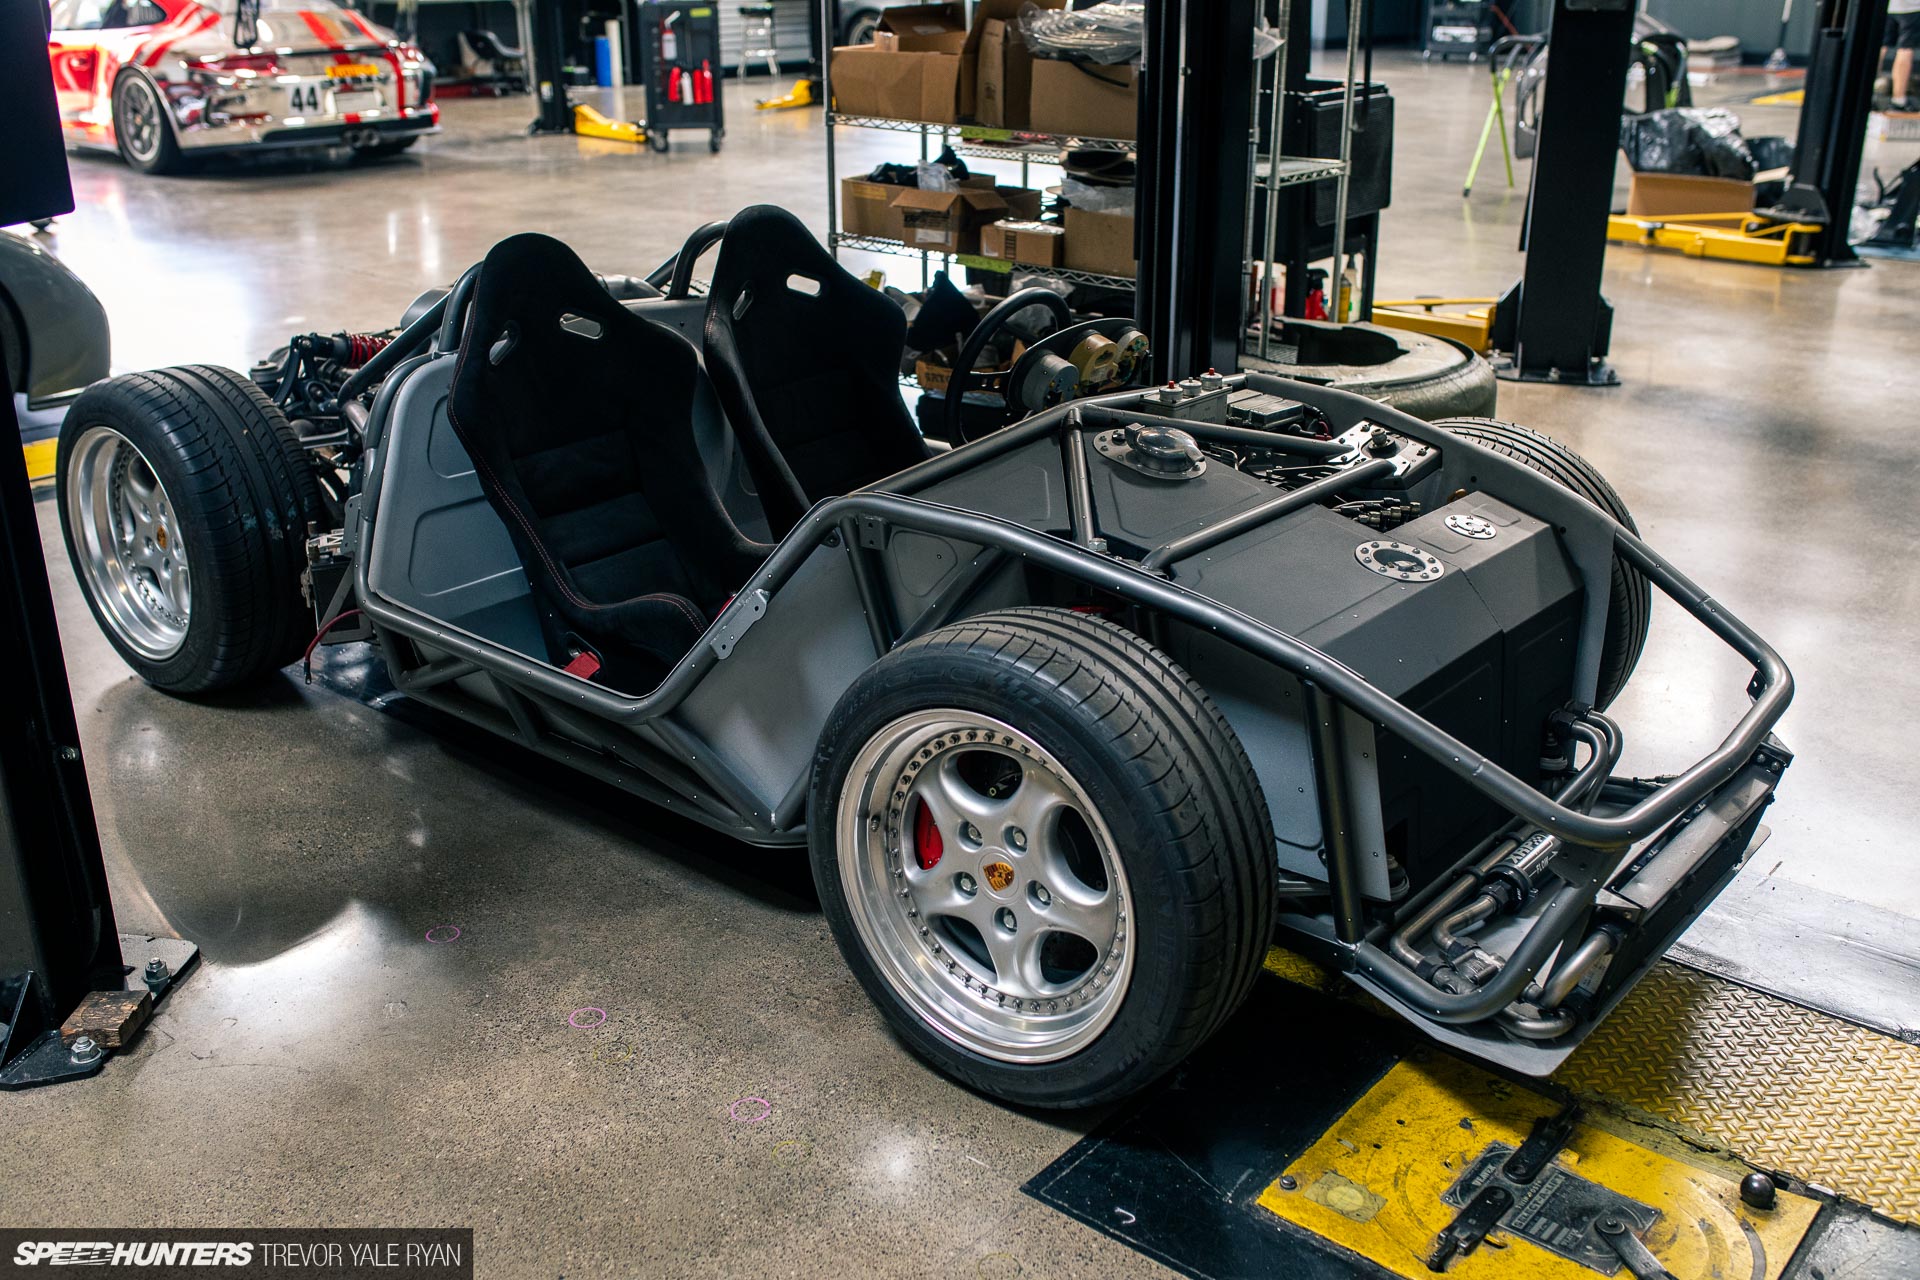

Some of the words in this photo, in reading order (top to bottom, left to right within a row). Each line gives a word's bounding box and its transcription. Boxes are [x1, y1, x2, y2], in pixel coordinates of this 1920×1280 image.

[291, 86, 318, 112] 44
[1508, 840, 1535, 865] XRP
[1535, 856, 1550, 875] FLOW
[1513, 1173, 1562, 1228] SELECT-A-LIFT
